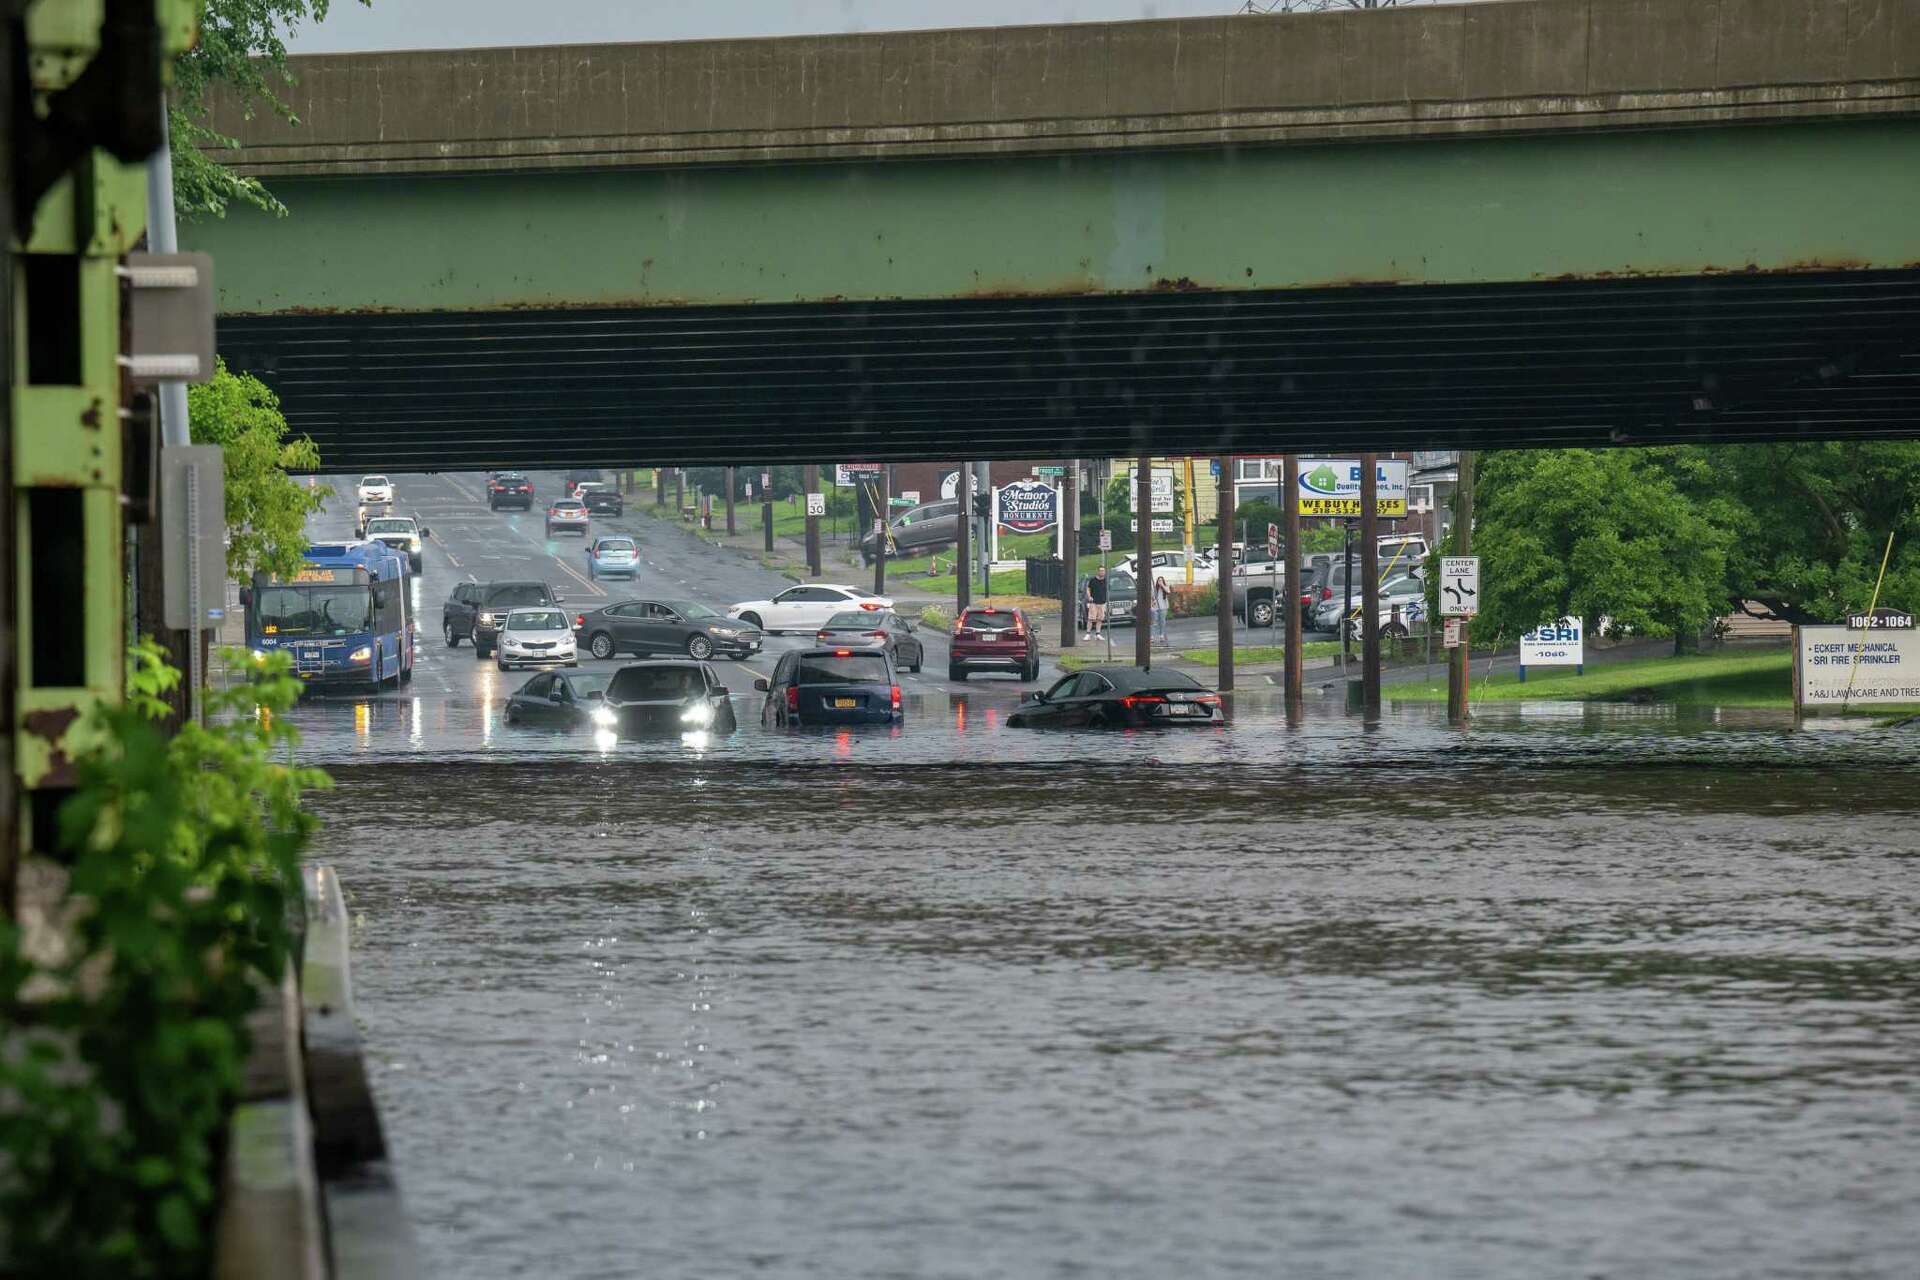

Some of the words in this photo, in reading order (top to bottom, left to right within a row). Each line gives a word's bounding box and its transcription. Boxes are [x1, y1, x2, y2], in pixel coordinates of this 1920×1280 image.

[1001, 489, 1054, 502] Memory
[809, 505, 823, 514] 30
[1006, 500, 1049, 512] Studios
[1303, 500, 1321, 508] WE
[1325, 500, 1348, 508] BUY
[1353, 500, 1399, 509] HSES
[1540, 628, 1578, 641] SRI
[1814, 644, 1844, 653] ECKERT
[1848, 643, 1897, 653] MECHANICAL
[1814, 656, 1828, 665] SRI
[1831, 655, 1849, 665] FIRE
[1853, 655, 1900, 665] SPRINKLER
[1814, 690, 1829, 699] A&J
[1832, 688, 1878, 699] LAWNCARE
[1879, 688, 1899, 697] AND
